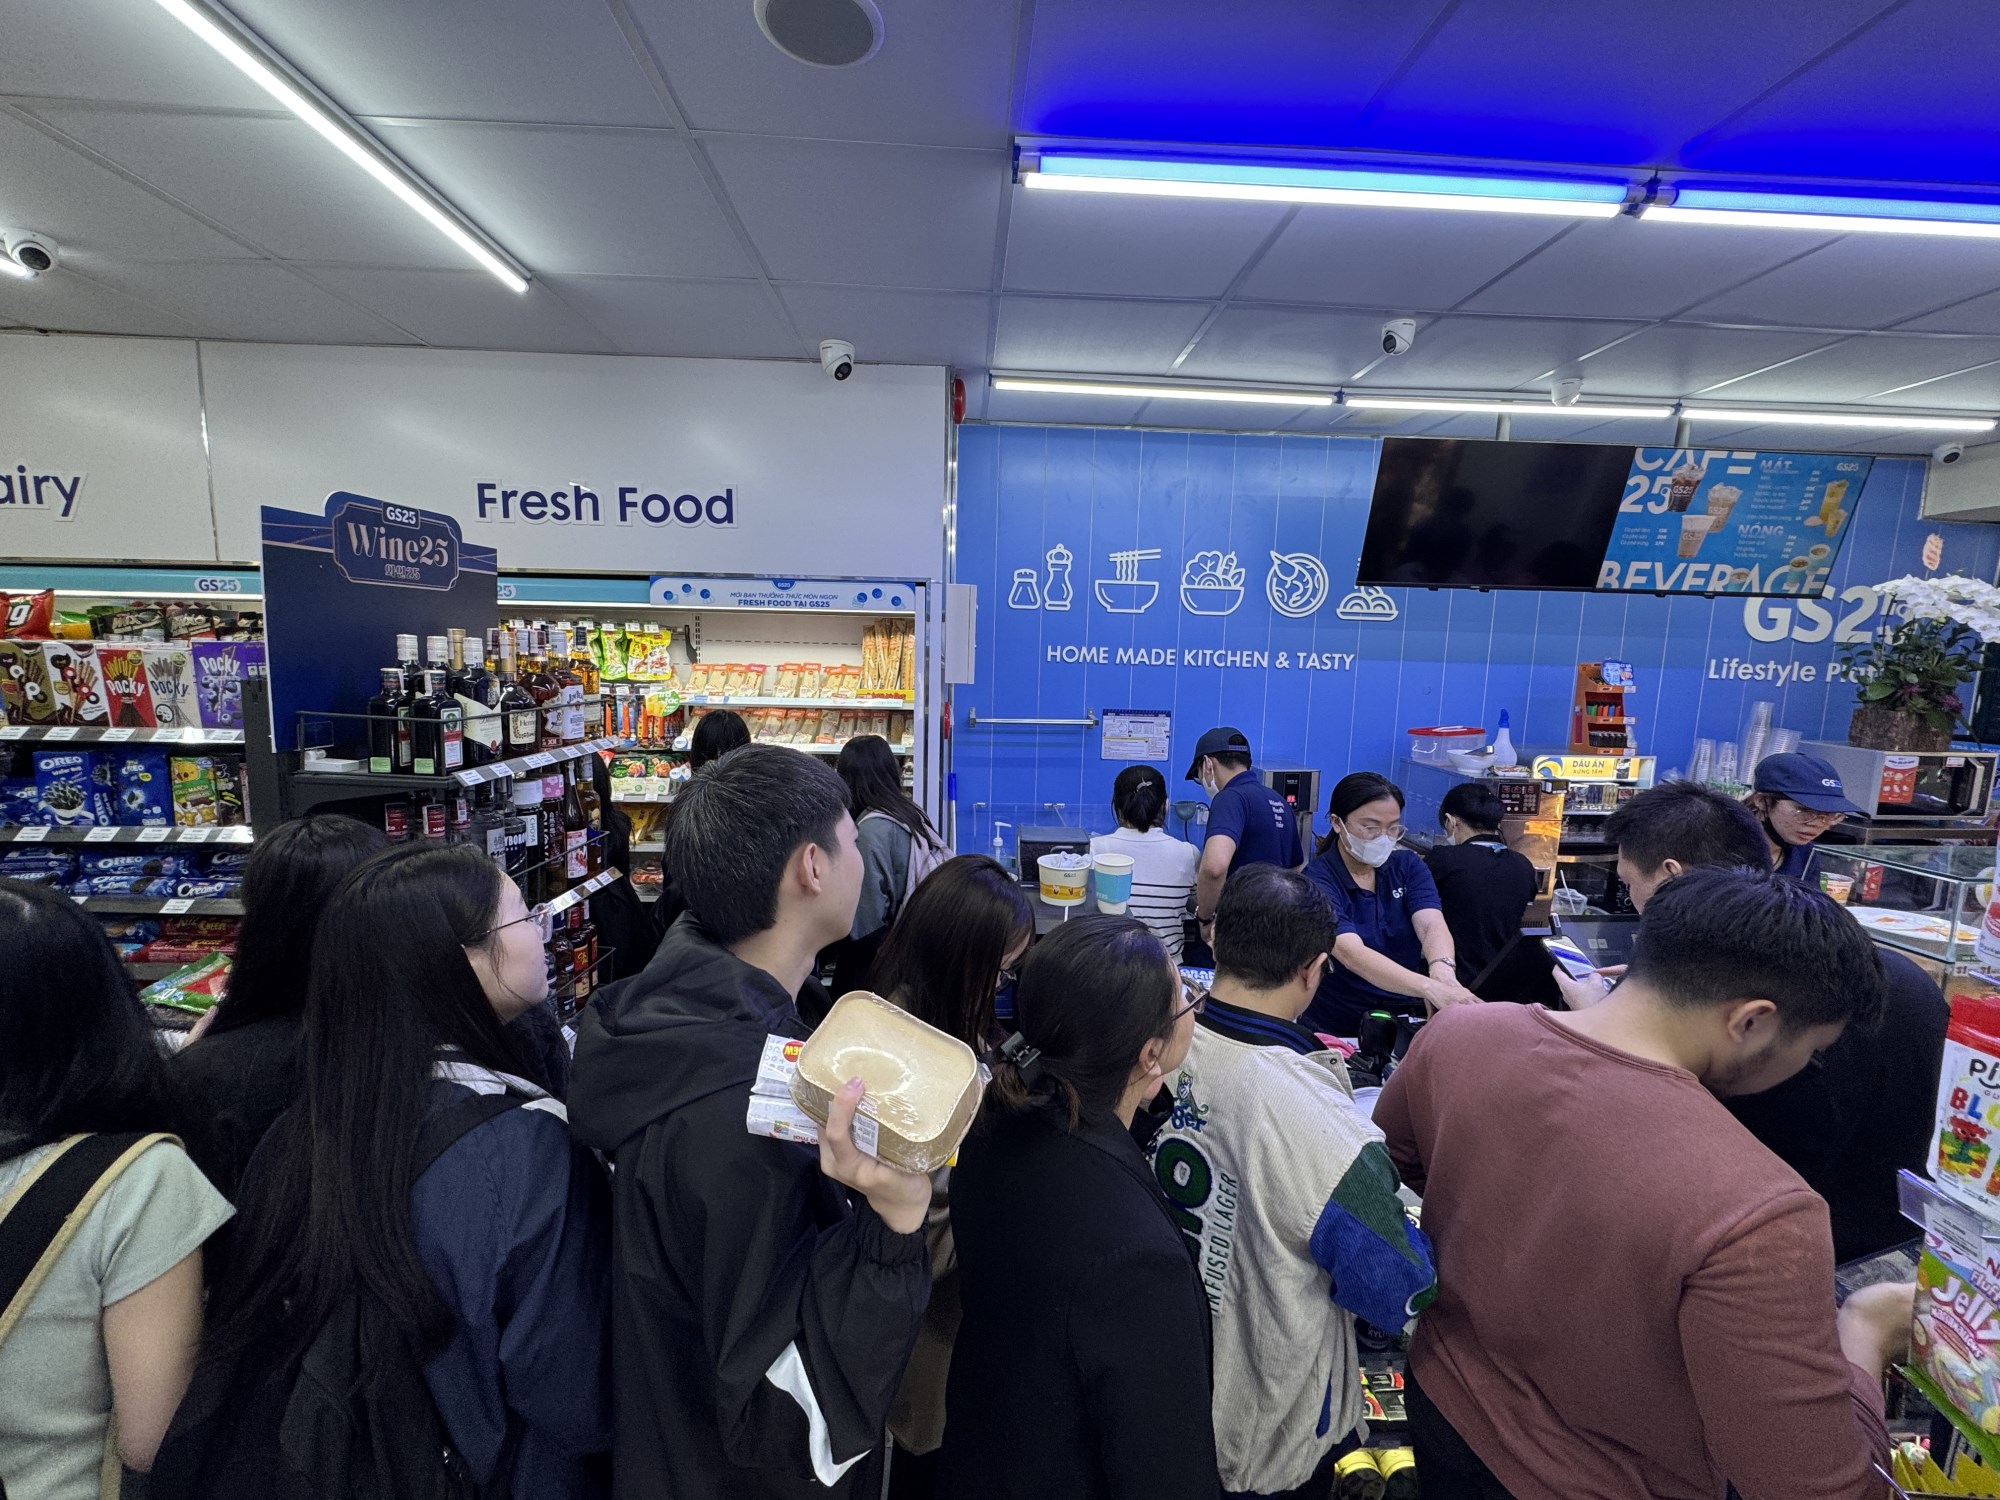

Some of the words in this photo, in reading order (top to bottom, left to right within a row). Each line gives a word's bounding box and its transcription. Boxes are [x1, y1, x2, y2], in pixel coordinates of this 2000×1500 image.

[1837, 463, 1859, 471] GS25
[1619, 475, 1673, 514] 25
[1673, 486, 1693, 494] GS25
[386, 506, 416, 524] GS25
[477, 483, 600, 521] Fresh
[618, 486, 734, 524] Food
[346, 521, 449, 568] Wine25
[199, 579, 237, 591] GS25
[1046, 645, 1109, 664] HOME
[1115, 648, 1176, 666] MADE
[1184, 649, 1268, 668] KITCHEN
[1275, 651, 1290, 669] &
[1297, 652, 1355, 671] TASTY
[1709, 658, 1816, 687] Lifestyle
[40, 756, 83, 770] OREO
[98, 856, 143, 869] OREO
[1213, 1172, 1238, 1233] LAGER
[1205, 1235, 1230, 1313] INFUSED
